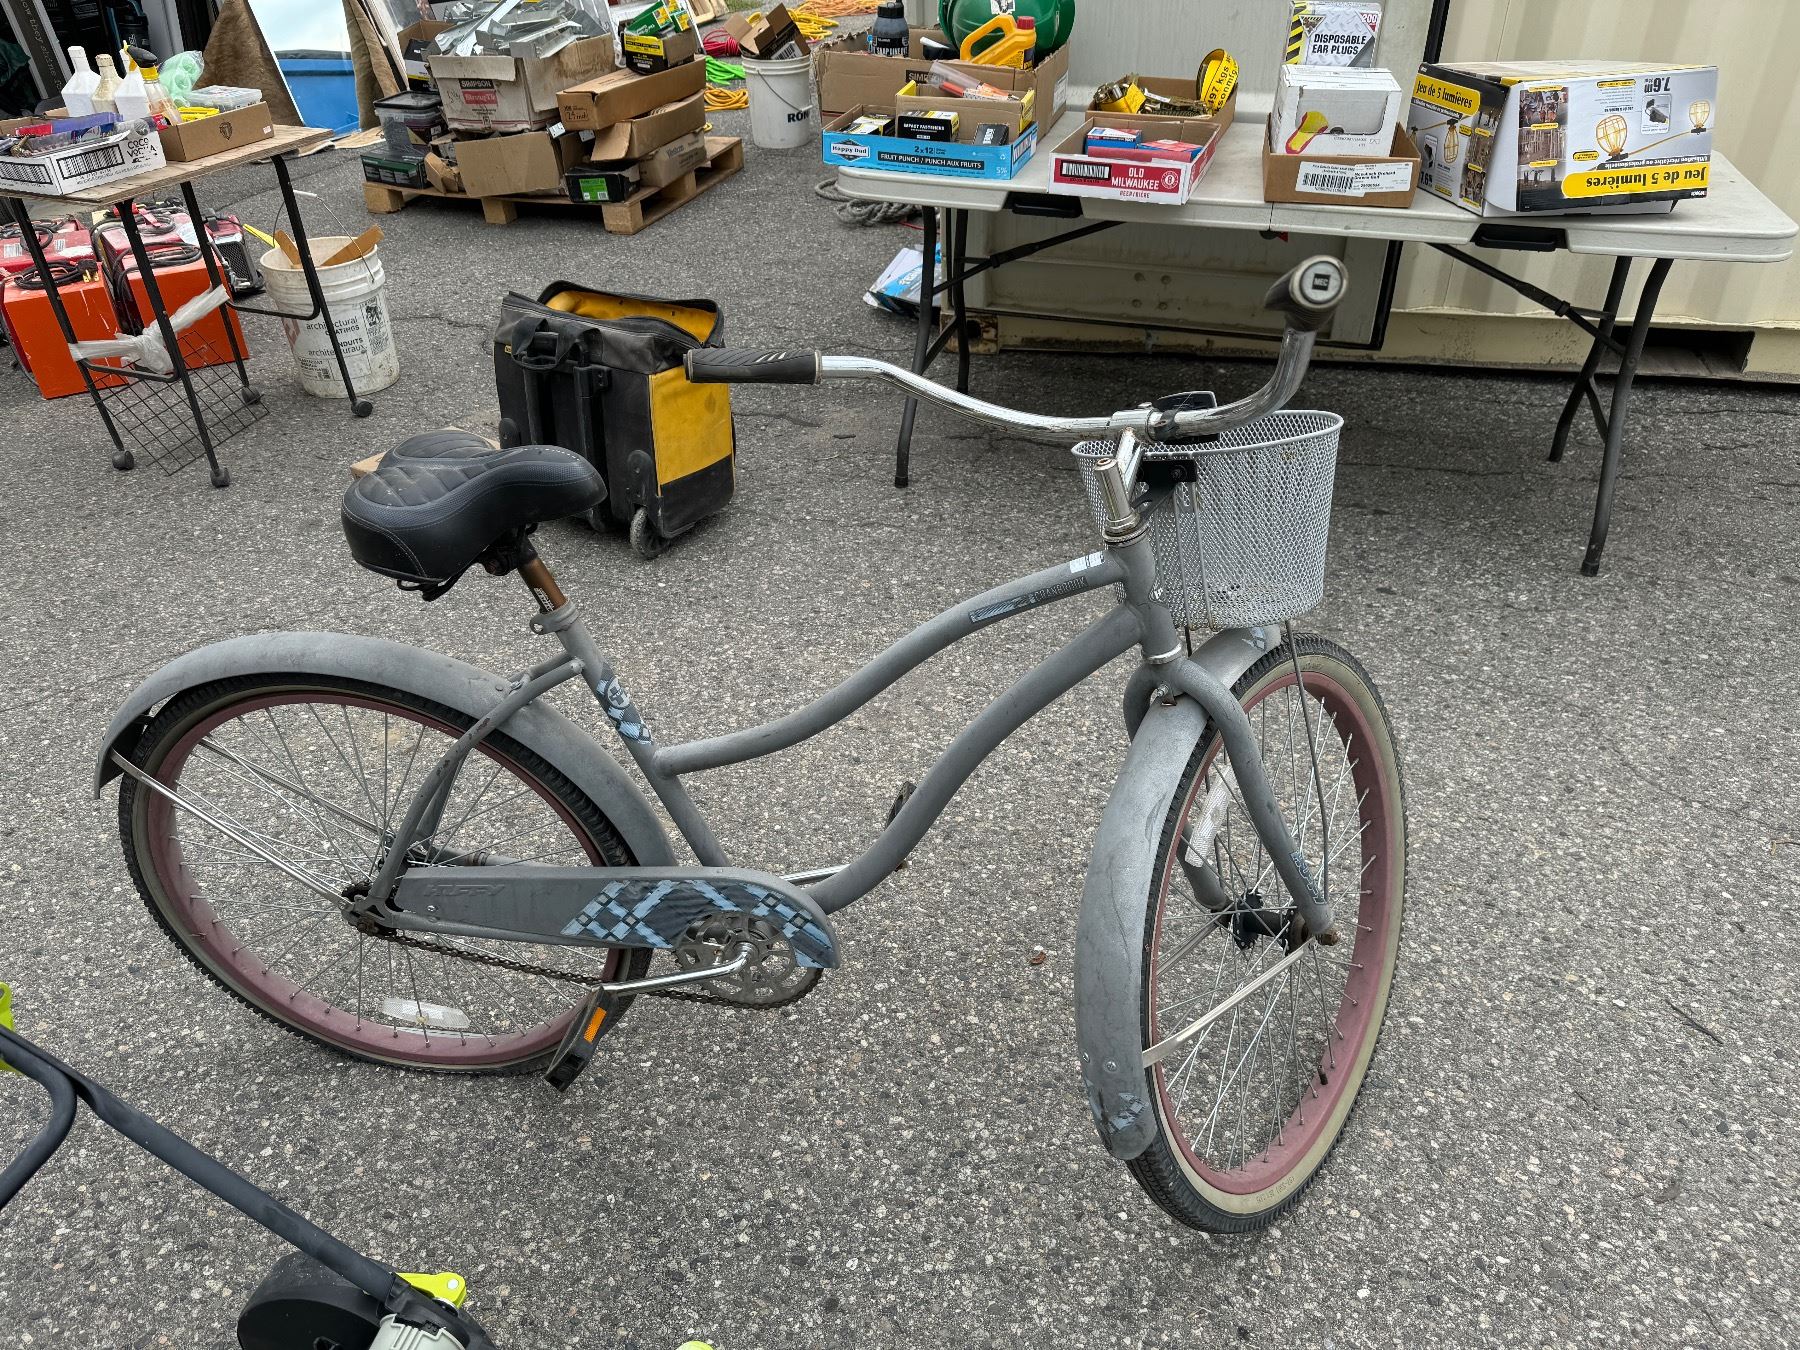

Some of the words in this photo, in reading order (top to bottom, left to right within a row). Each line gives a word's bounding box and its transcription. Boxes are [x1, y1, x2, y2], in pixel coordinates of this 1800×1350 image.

[1361, 14, 1378, 23] 200
[1313, 33, 1367, 45] DISPOSABLE
[1312, 44, 1329, 54] EAR
[1330, 45, 1359, 55] PLUGS
[1216, 66, 1229, 85] kgs
[461, 79, 492, 88] SIMPSON
[1428, 83, 1436, 97] de
[1436, 86, 1442, 99] 5
[1442, 88, 1473, 109] lumières
[832, 145, 853, 154] Happy
[880, 153, 898, 161] FRUIT
[898, 155, 920, 163] PUNCH
[925, 158, 946, 166] PUNCH
[960, 161, 982, 169] FRUITS
[1128, 167, 1144, 177] OLD
[1652, 172, 1660, 185] 5
[1663, 170, 1680, 184] de
[1684, 166, 1706, 181] Jeu
[1111, 177, 1159, 190] MILWAUKEE
[1586, 174, 1647, 190] lumières
[1313, 277, 1328, 286] MEC
[424, 884, 505, 897] HUFFY
